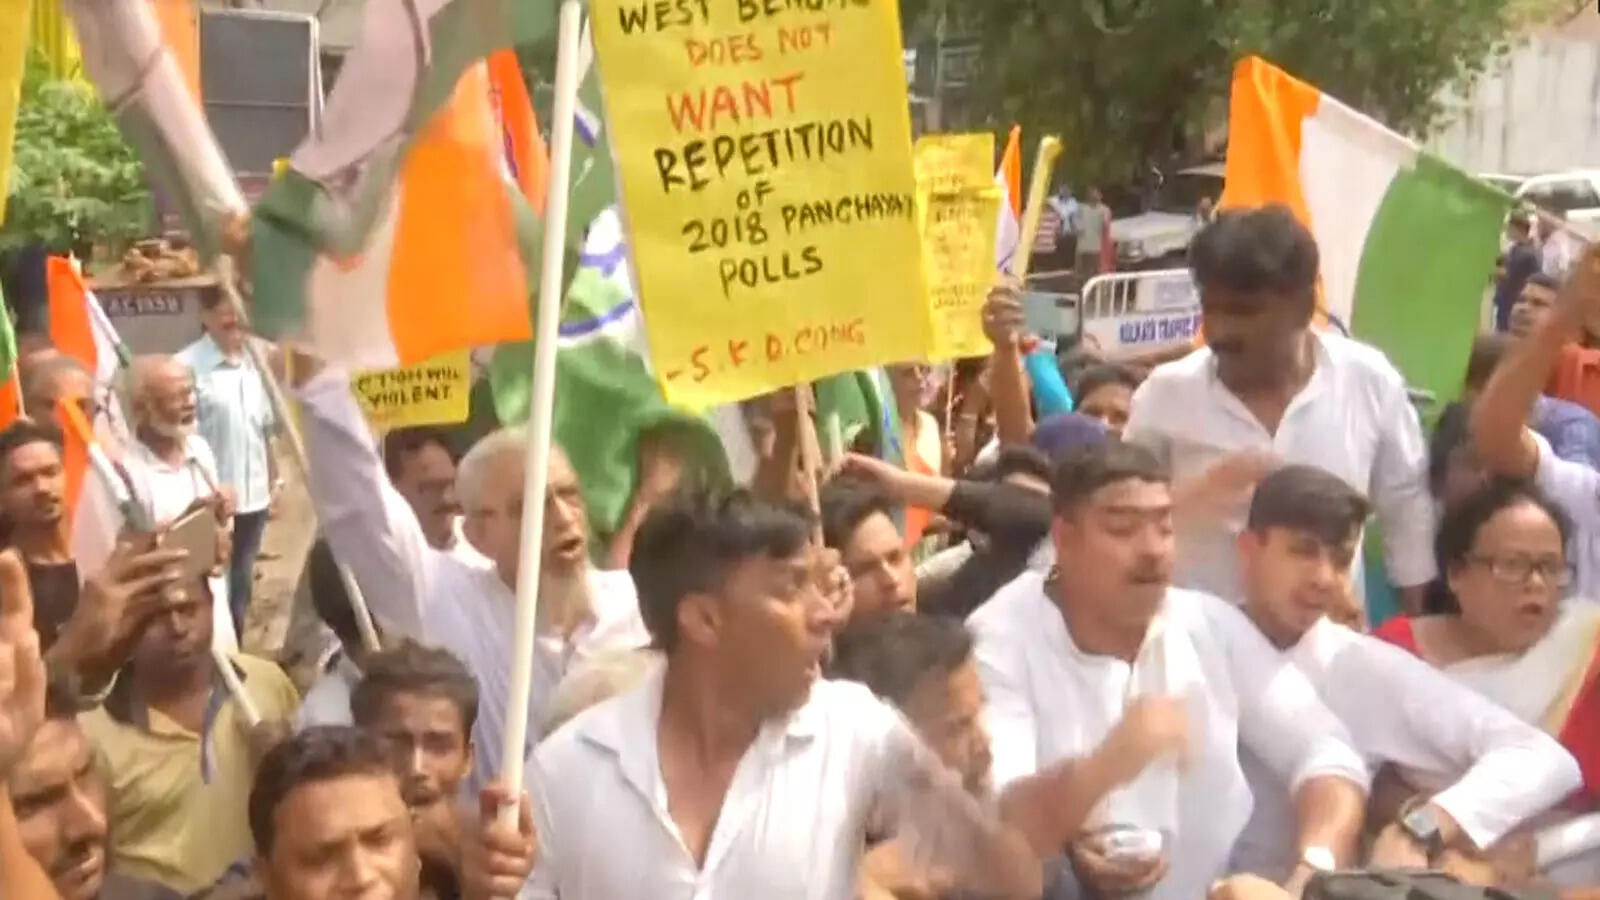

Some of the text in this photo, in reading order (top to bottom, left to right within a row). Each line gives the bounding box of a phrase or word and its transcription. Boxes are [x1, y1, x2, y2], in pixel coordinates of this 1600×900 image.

[618, 0, 871, 34] WEST BENG
[684, 22, 831, 67] DOES NOT
[666, 71, 804, 134] WANT
[653, 117, 873, 193] REPETITION
[736, 180, 775, 210] OF
[681, 211, 769, 254] 2018
[719, 246, 824, 301] POLLS
[367, 384, 451, 408] VIOLENT
